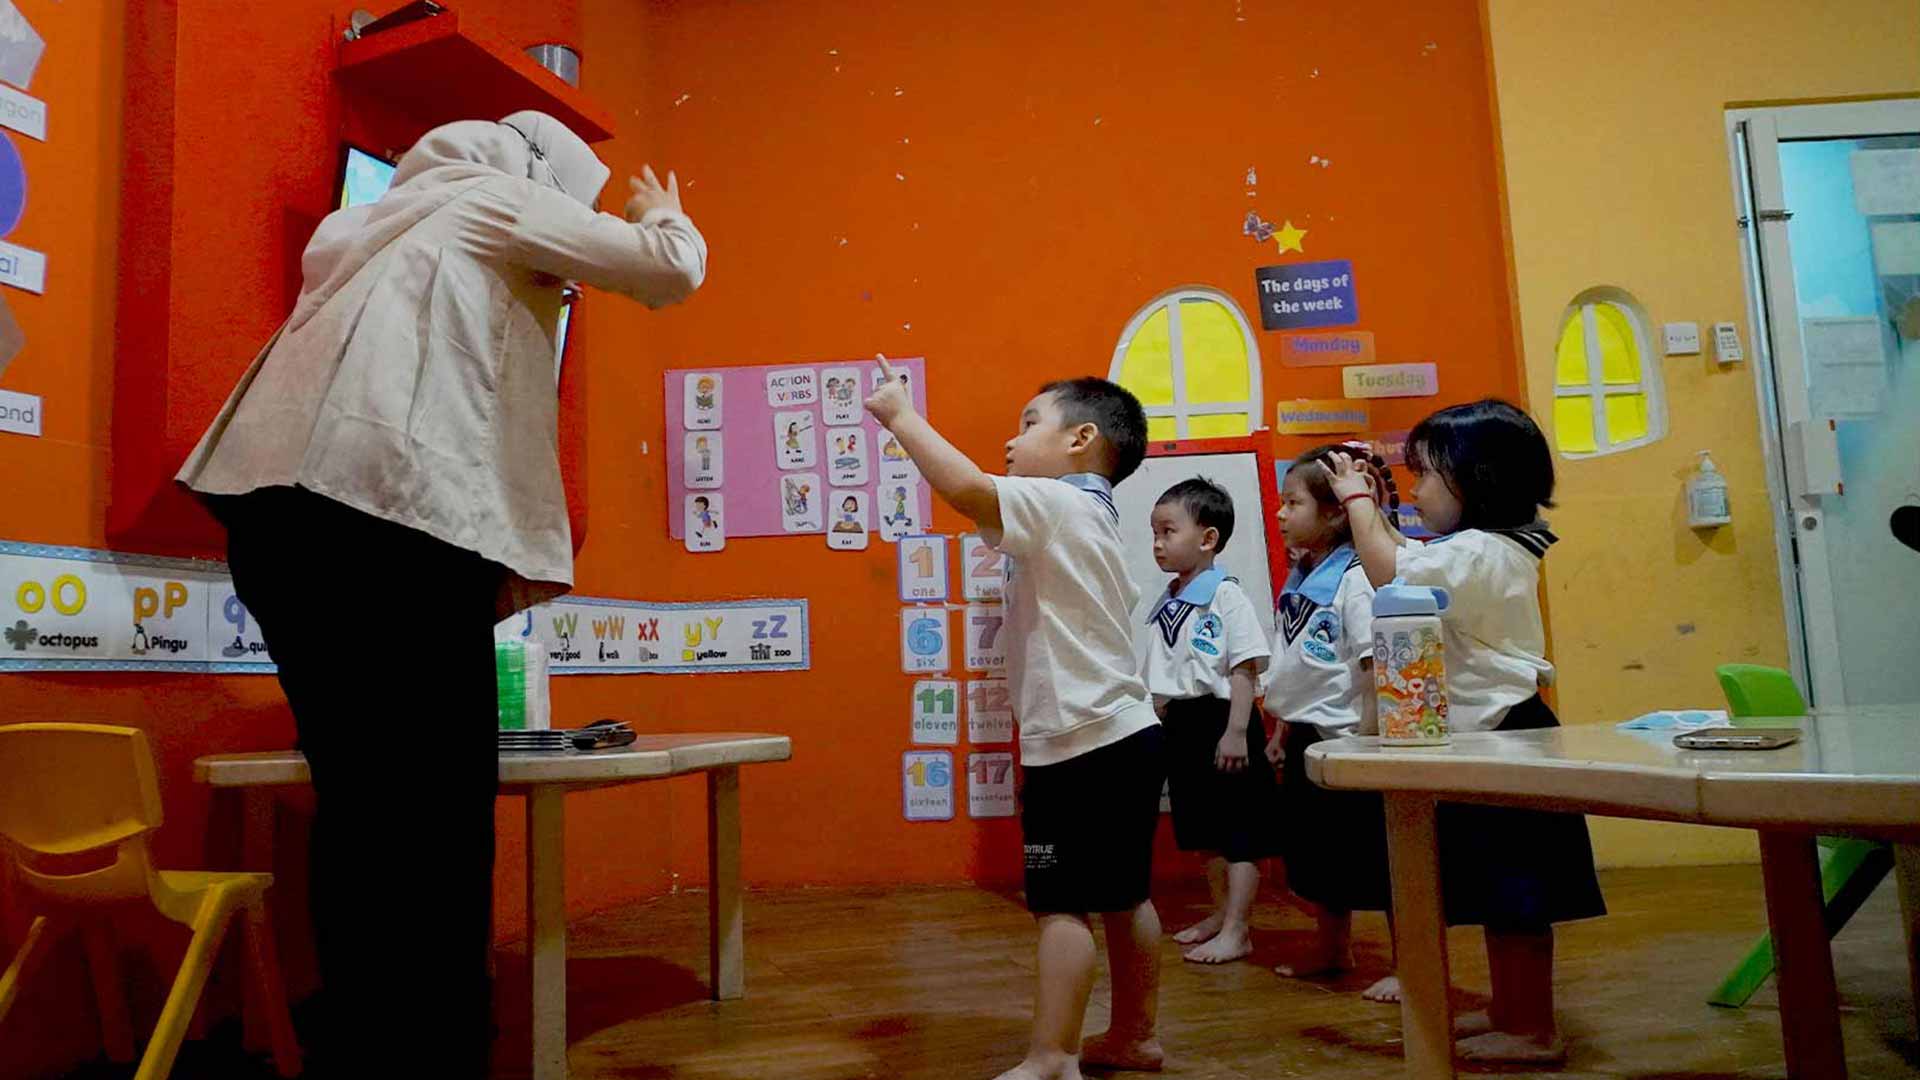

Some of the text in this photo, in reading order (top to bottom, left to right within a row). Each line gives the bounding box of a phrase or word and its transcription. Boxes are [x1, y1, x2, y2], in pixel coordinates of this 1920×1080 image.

[0, 97, 41, 124] gon
[1261, 274, 1349, 293] The days of
[1273, 296, 1344, 314] the week
[1354, 371, 1426, 389] Tuesday
[909, 545, 934, 578] 1
[971, 545, 1003, 577] 2
[912, 587, 936, 597] one
[975, 584, 1000, 596] two
[39, 631, 98, 651] octopus
[907, 617, 943, 656] 6
[971, 616, 1003, 649] 7
[151, 635, 188, 653] Pingu
[774, 649, 792, 657] zoo
[696, 649, 728, 661] yellow
[916, 658, 936, 667] six
[916, 687, 955, 714] 11
[969, 687, 1010, 713] 12
[915, 718, 956, 730] eleven
[970, 718, 1011, 730] twelve
[907, 760, 949, 788] 16
[969, 760, 1012, 785] 17
